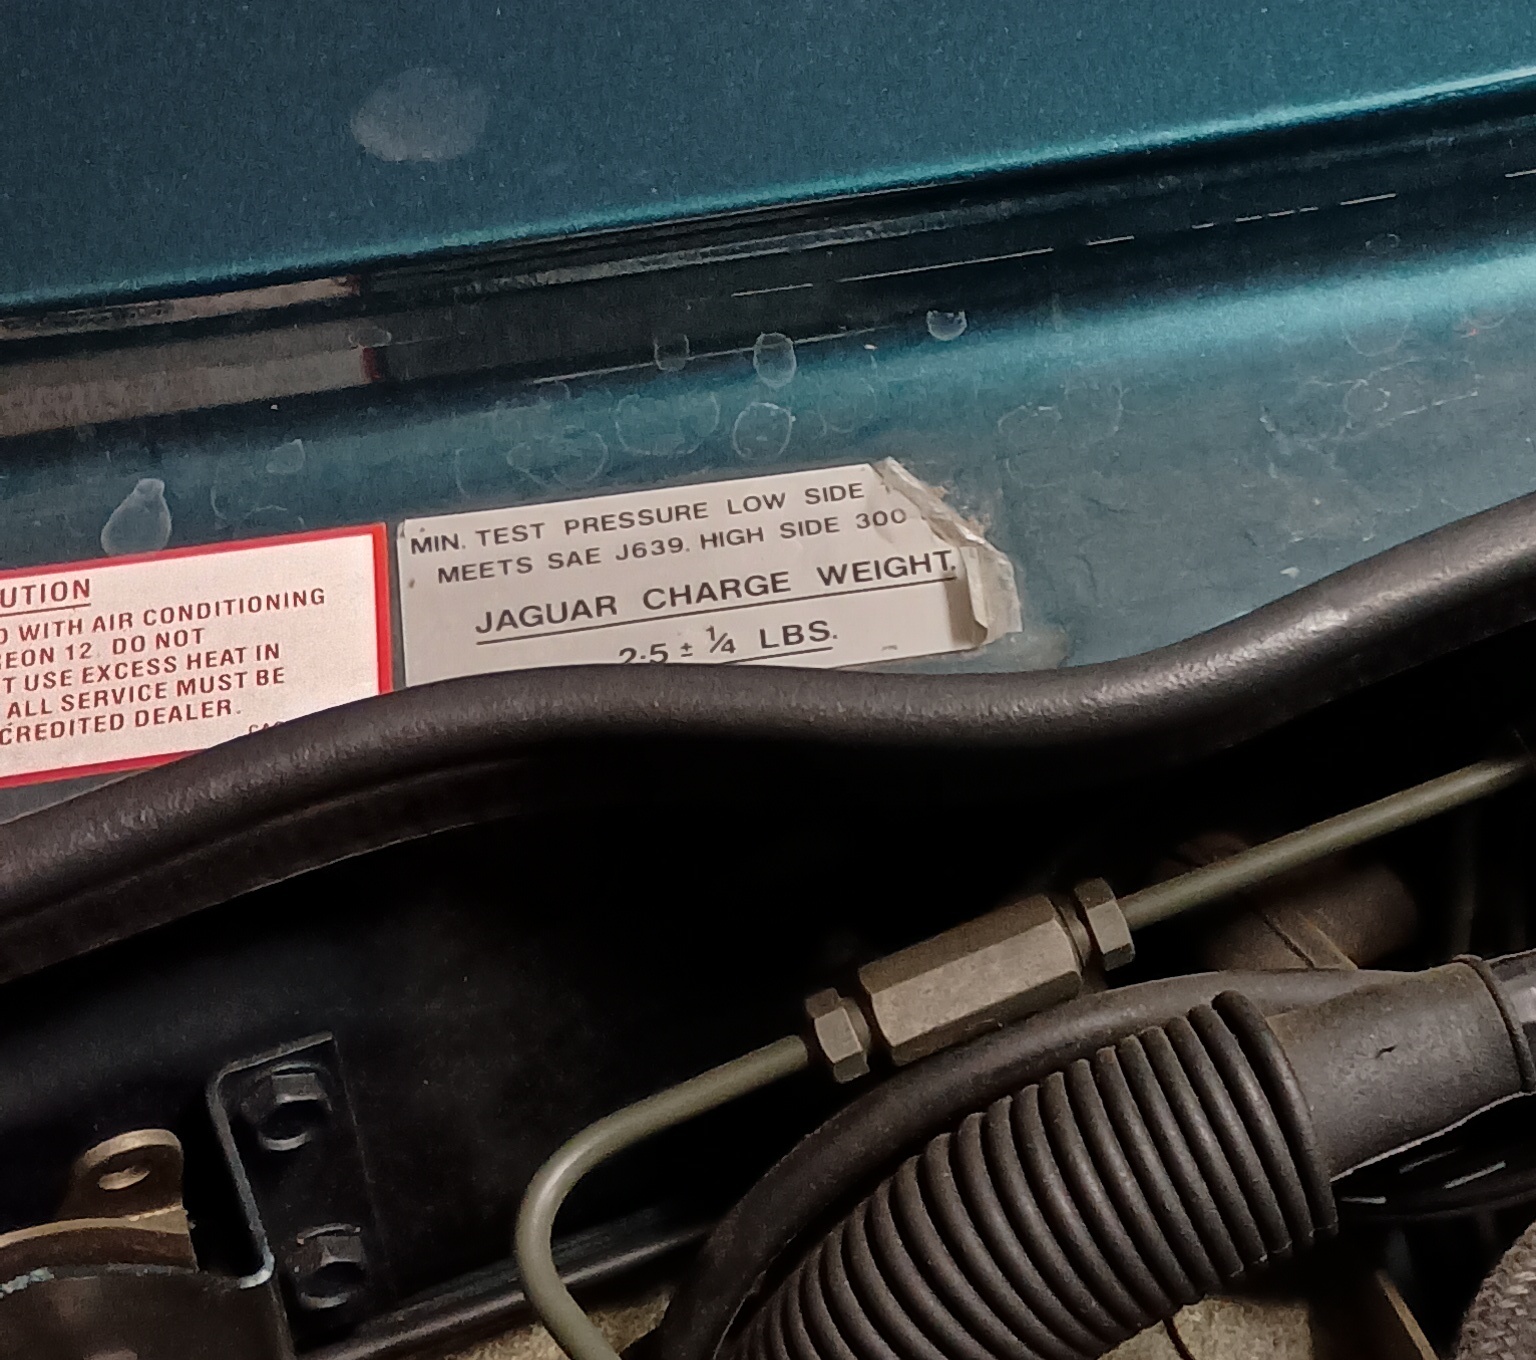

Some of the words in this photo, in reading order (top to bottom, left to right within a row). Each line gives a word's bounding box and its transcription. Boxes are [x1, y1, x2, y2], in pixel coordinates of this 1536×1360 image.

[410, 532, 467, 555] MIN.
[475, 522, 546, 547] TEST
[563, 501, 709, 536] PRESSURE
[726, 491, 787, 515] LOW
[804, 482, 865, 505] SIDE
[437, 556, 534, 584] MEETS
[547, 547, 602, 570] SAE
[614, 536, 691, 561] J639.
[700, 526, 765, 551] HIGH
[779, 516, 841, 539] SIDE
[856, 507, 908, 530] 300
[19, 616, 83, 642] WITH
[92, 611, 133, 633] AIR
[142, 587, 326, 628] CONDITIONING
[474, 595, 618, 634] JAGUAR
[642, 570, 792, 610] CHARGE
[815, 550, 957, 587] WEIGHT.
[0, 645, 55, 669] EON
[66, 642, 92, 661] 12
[112, 634, 147, 655] DO
[155, 628, 206, 648] NOT
[758, 619, 839, 650] LBS.
[6, 698, 53, 720] ALL
[60, 681, 168, 713] SERVICE
[176, 671, 248, 697] MUST
[256, 666, 286, 687] BE
[24, 668, 73, 692] USE
[81, 654, 178, 684] EXCESS
[186, 645, 247, 671] HEAT
[255, 643, 281, 663] IN
[134, 698, 243, 729] DEALER.
